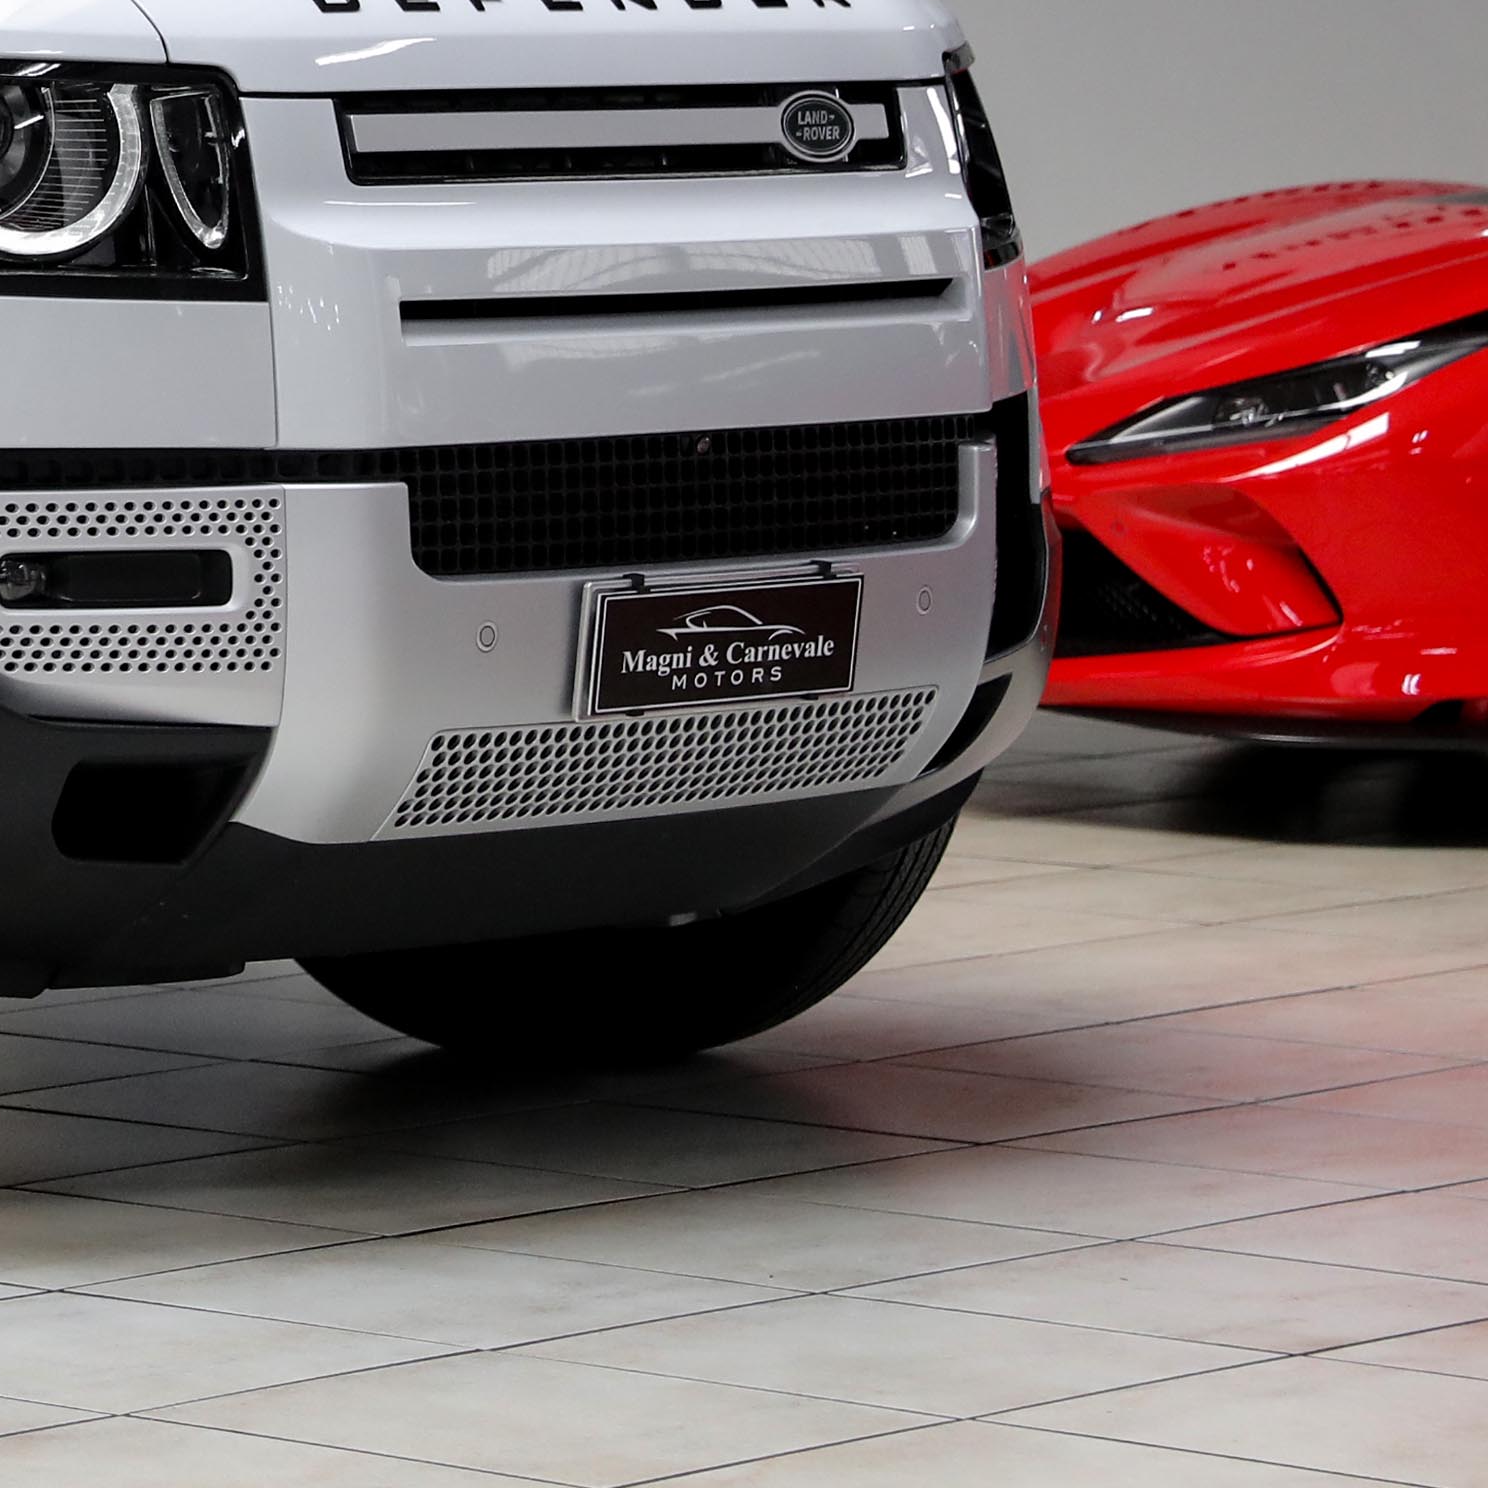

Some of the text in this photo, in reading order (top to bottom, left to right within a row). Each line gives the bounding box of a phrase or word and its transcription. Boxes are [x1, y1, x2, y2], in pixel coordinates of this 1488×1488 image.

[620, 634, 835, 677] Magni & Carnevale
[671, 665, 782, 691] MOTORS
